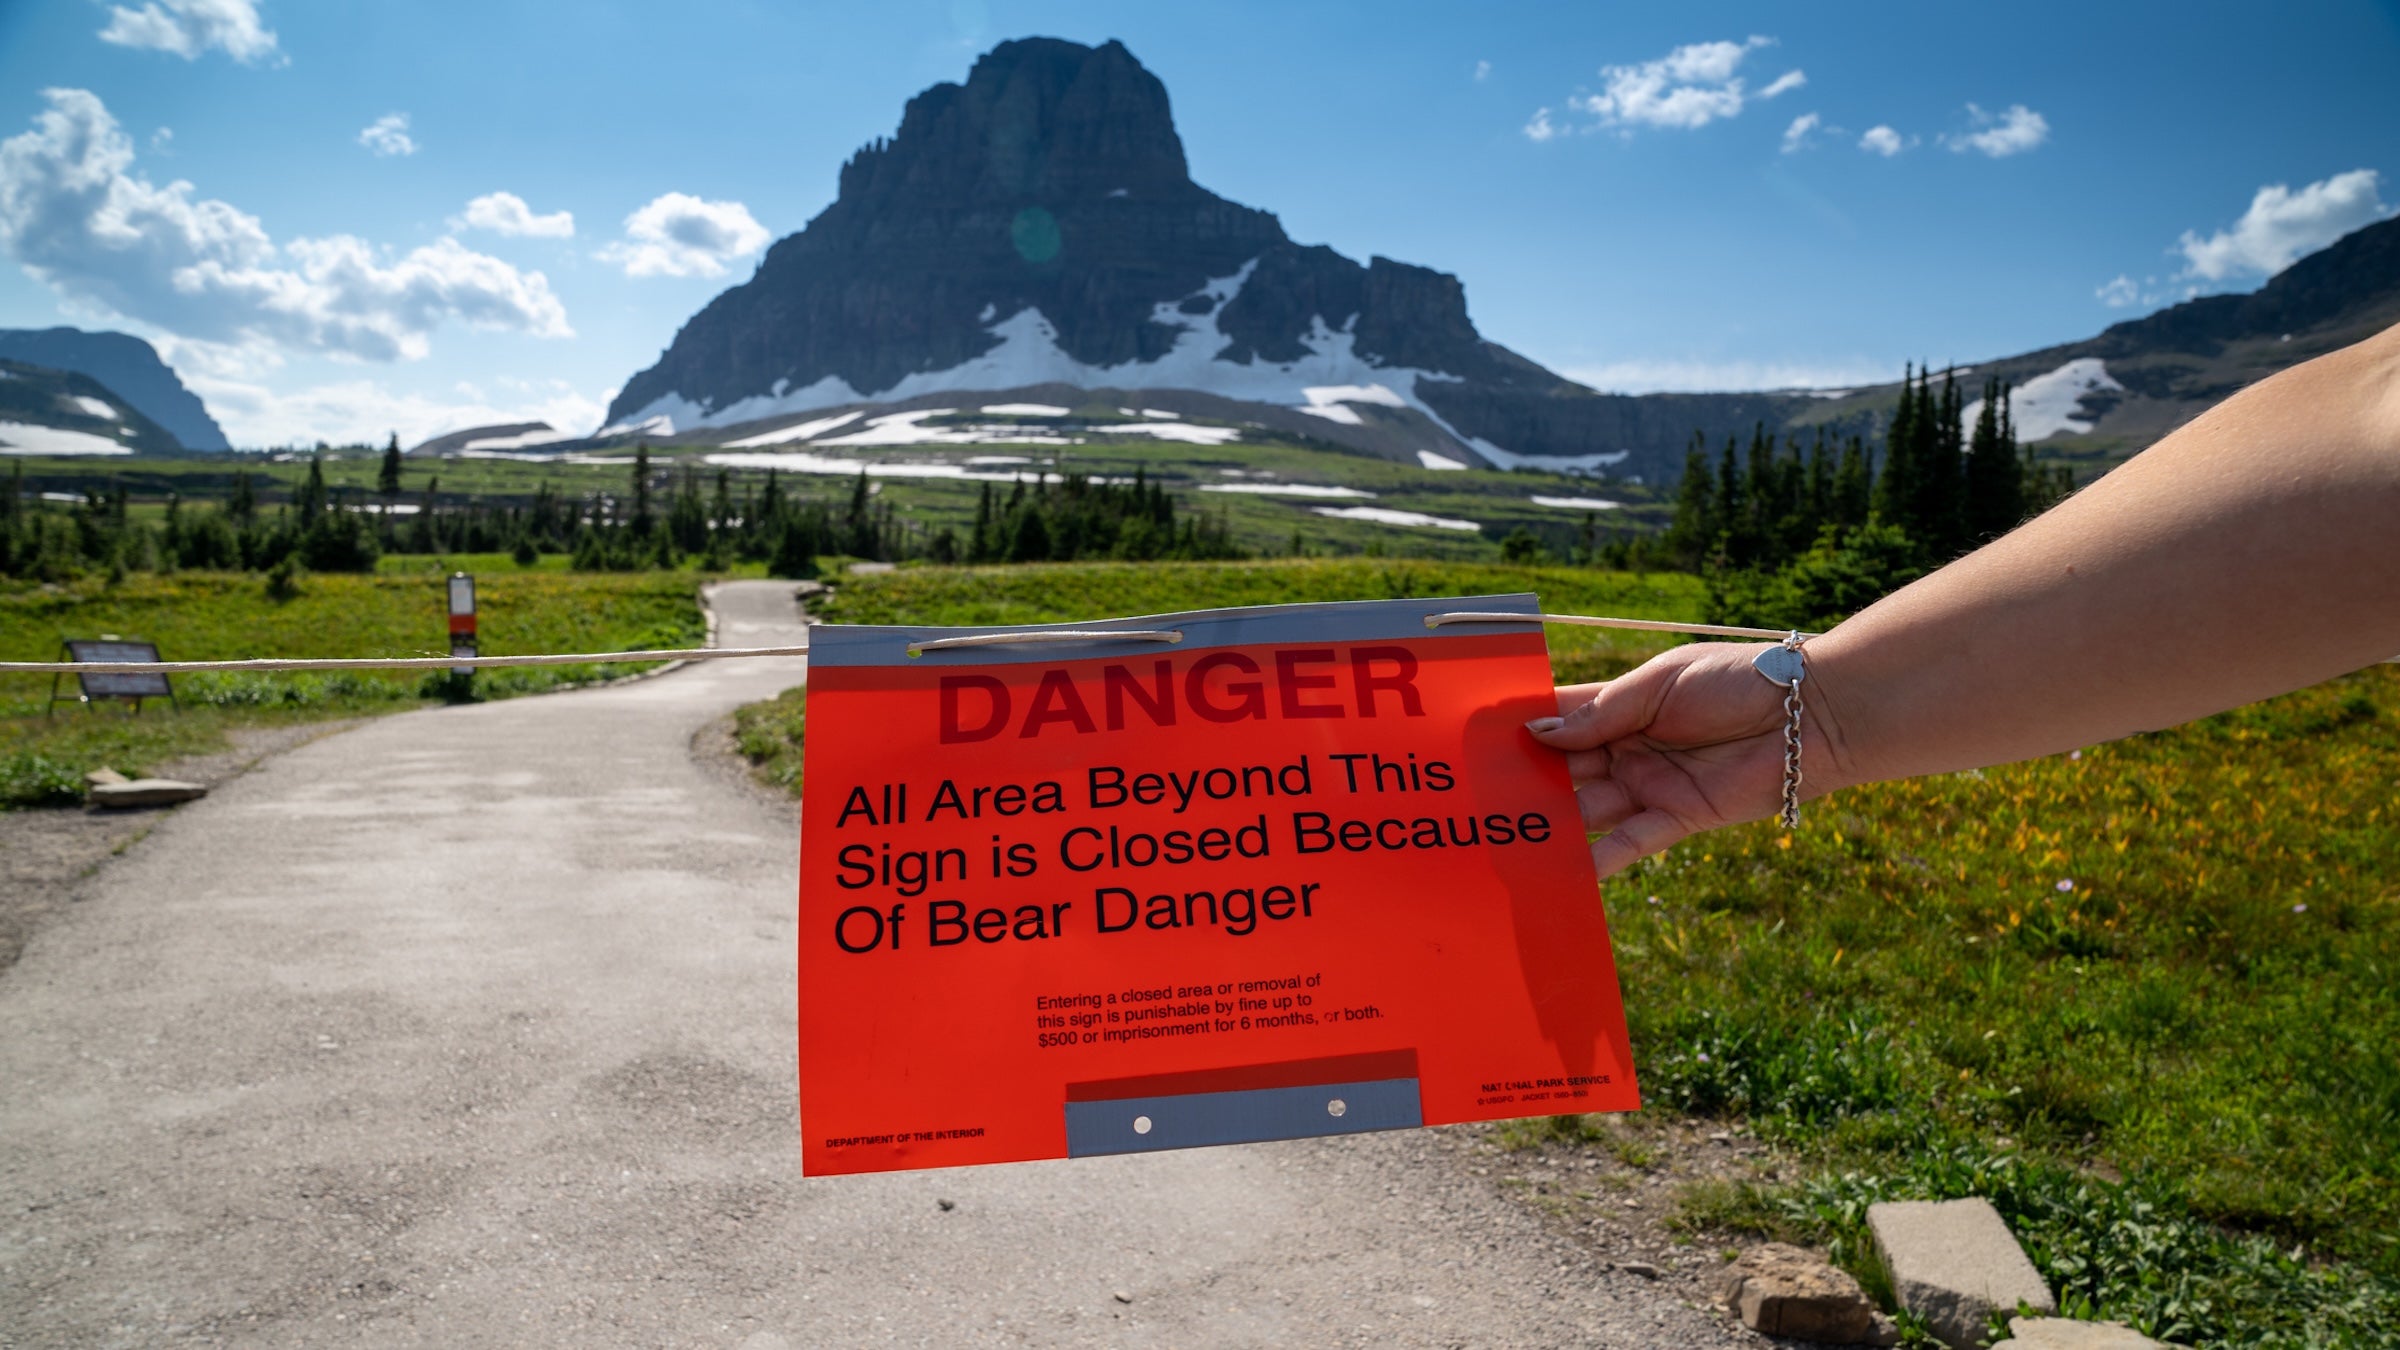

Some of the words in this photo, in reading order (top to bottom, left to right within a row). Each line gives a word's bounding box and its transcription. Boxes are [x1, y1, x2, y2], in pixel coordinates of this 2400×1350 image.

[938, 646, 1426, 745] DANGER
[836, 784, 906, 828] All
[926, 780, 1066, 822] Area
[1088, 754, 1312, 814] Beyond
[1329, 753, 1454, 793] This
[836, 842, 966, 897] Sign
[992, 835, 1038, 878] is
[1060, 814, 1270, 872] Closed
[1292, 812, 1550, 854] Because
[835, 904, 905, 954] Of
[929, 900, 1072, 946] Bear
[1095, 882, 1320, 936] Danger
[1037, 994, 1102, 1010] Entering
[1107, 994, 1117, 1004] a
[1121, 986, 1172, 1003] closed
[1178, 986, 1213, 998] area
[1217, 984, 1233, 995] or
[1238, 975, 1301, 992] removal
[1306, 973, 1320, 987] of
[1037, 1014, 1065, 1028] this
[1070, 1012, 1102, 1028] sign
[1107, 1010, 1120, 1022] is
[1124, 1002, 1210, 1024] punishable
[1215, 1000, 1234, 1016] by
[1238, 998, 1267, 1011] fine
[1272, 997, 1292, 1011] up
[1296, 994, 1312, 1006] to
[1038, 1031, 1078, 1048] $500
[1082, 1032, 1098, 1043] or
[1104, 1020, 1210, 1043] imprisonment
[1214, 1018, 1236, 1032] for
[1240, 1016, 1251, 1030] 6
[1256, 1012, 1319, 1028] months,
[1344, 1006, 1384, 1021] both.
[1521, 1092, 1550, 1101] JACKET
[1537, 1078, 1565, 1089] PARK
[1567, 1075, 1611, 1086] SERVICE
[826, 1135, 894, 1148] DEPARTMENT
[896, 1133, 911, 1143] OF
[913, 1131, 934, 1141] THE
[935, 1128, 985, 1140] INTERIOR
